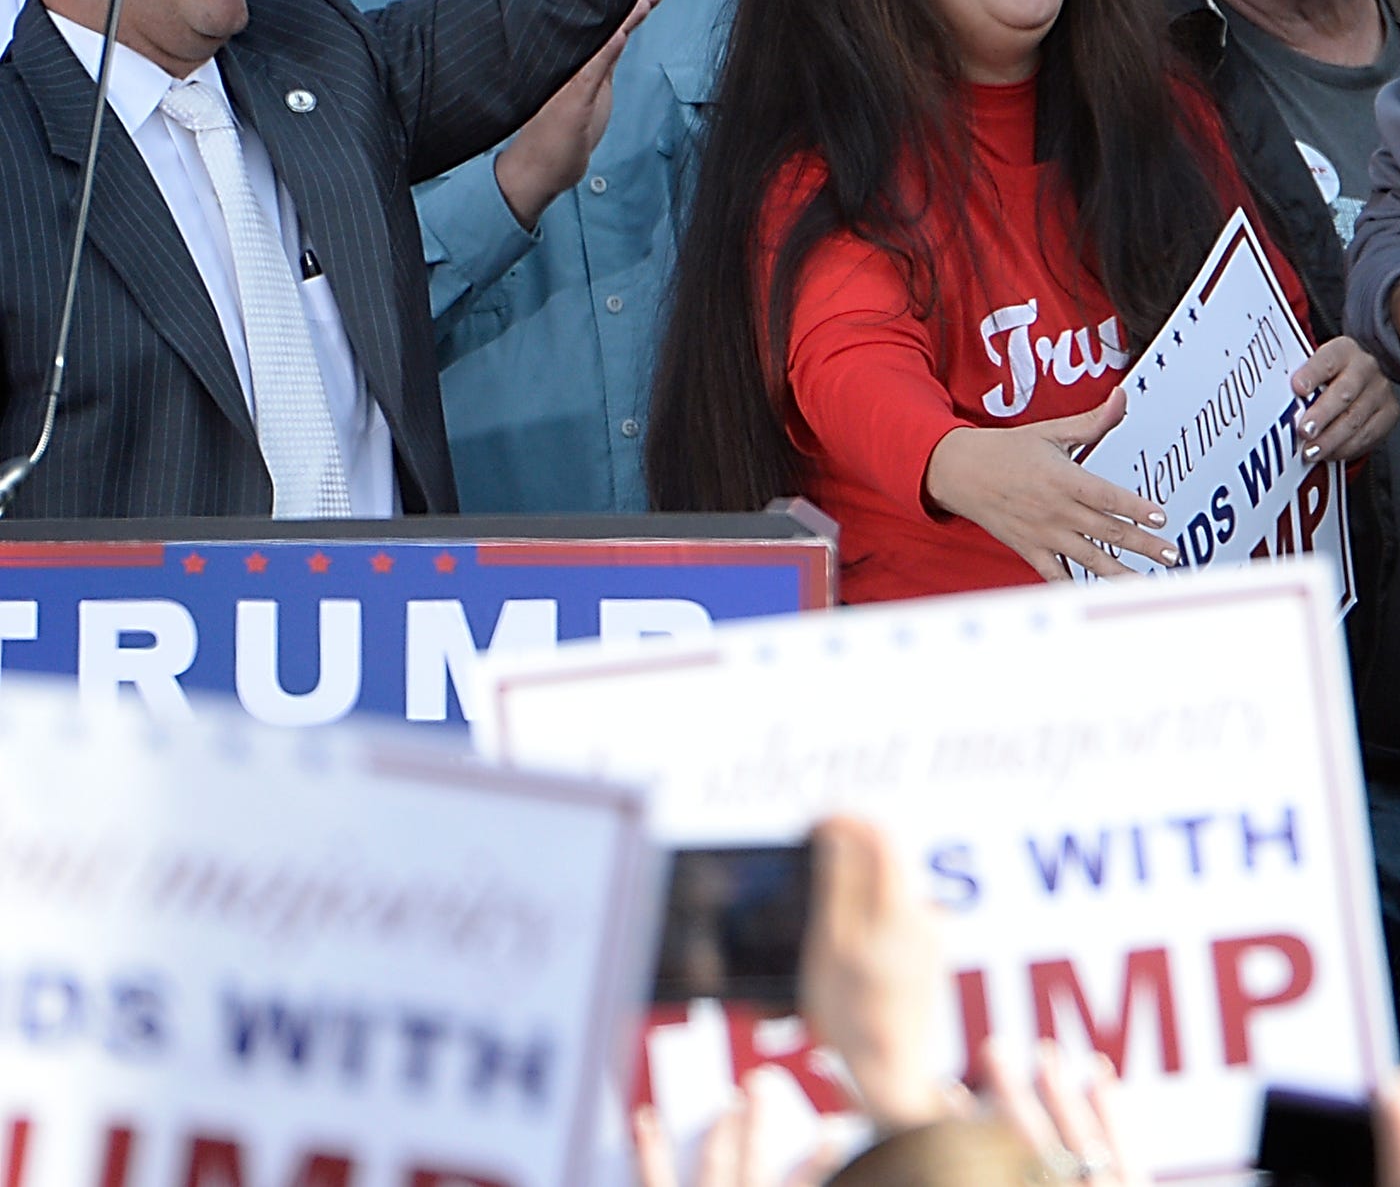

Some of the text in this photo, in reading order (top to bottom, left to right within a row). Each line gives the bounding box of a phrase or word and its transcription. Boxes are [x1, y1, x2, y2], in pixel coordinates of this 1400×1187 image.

[1133, 426, 1196, 506] ilent
[1197, 306, 1291, 457] majority
[1026, 807, 1303, 894] WITH
